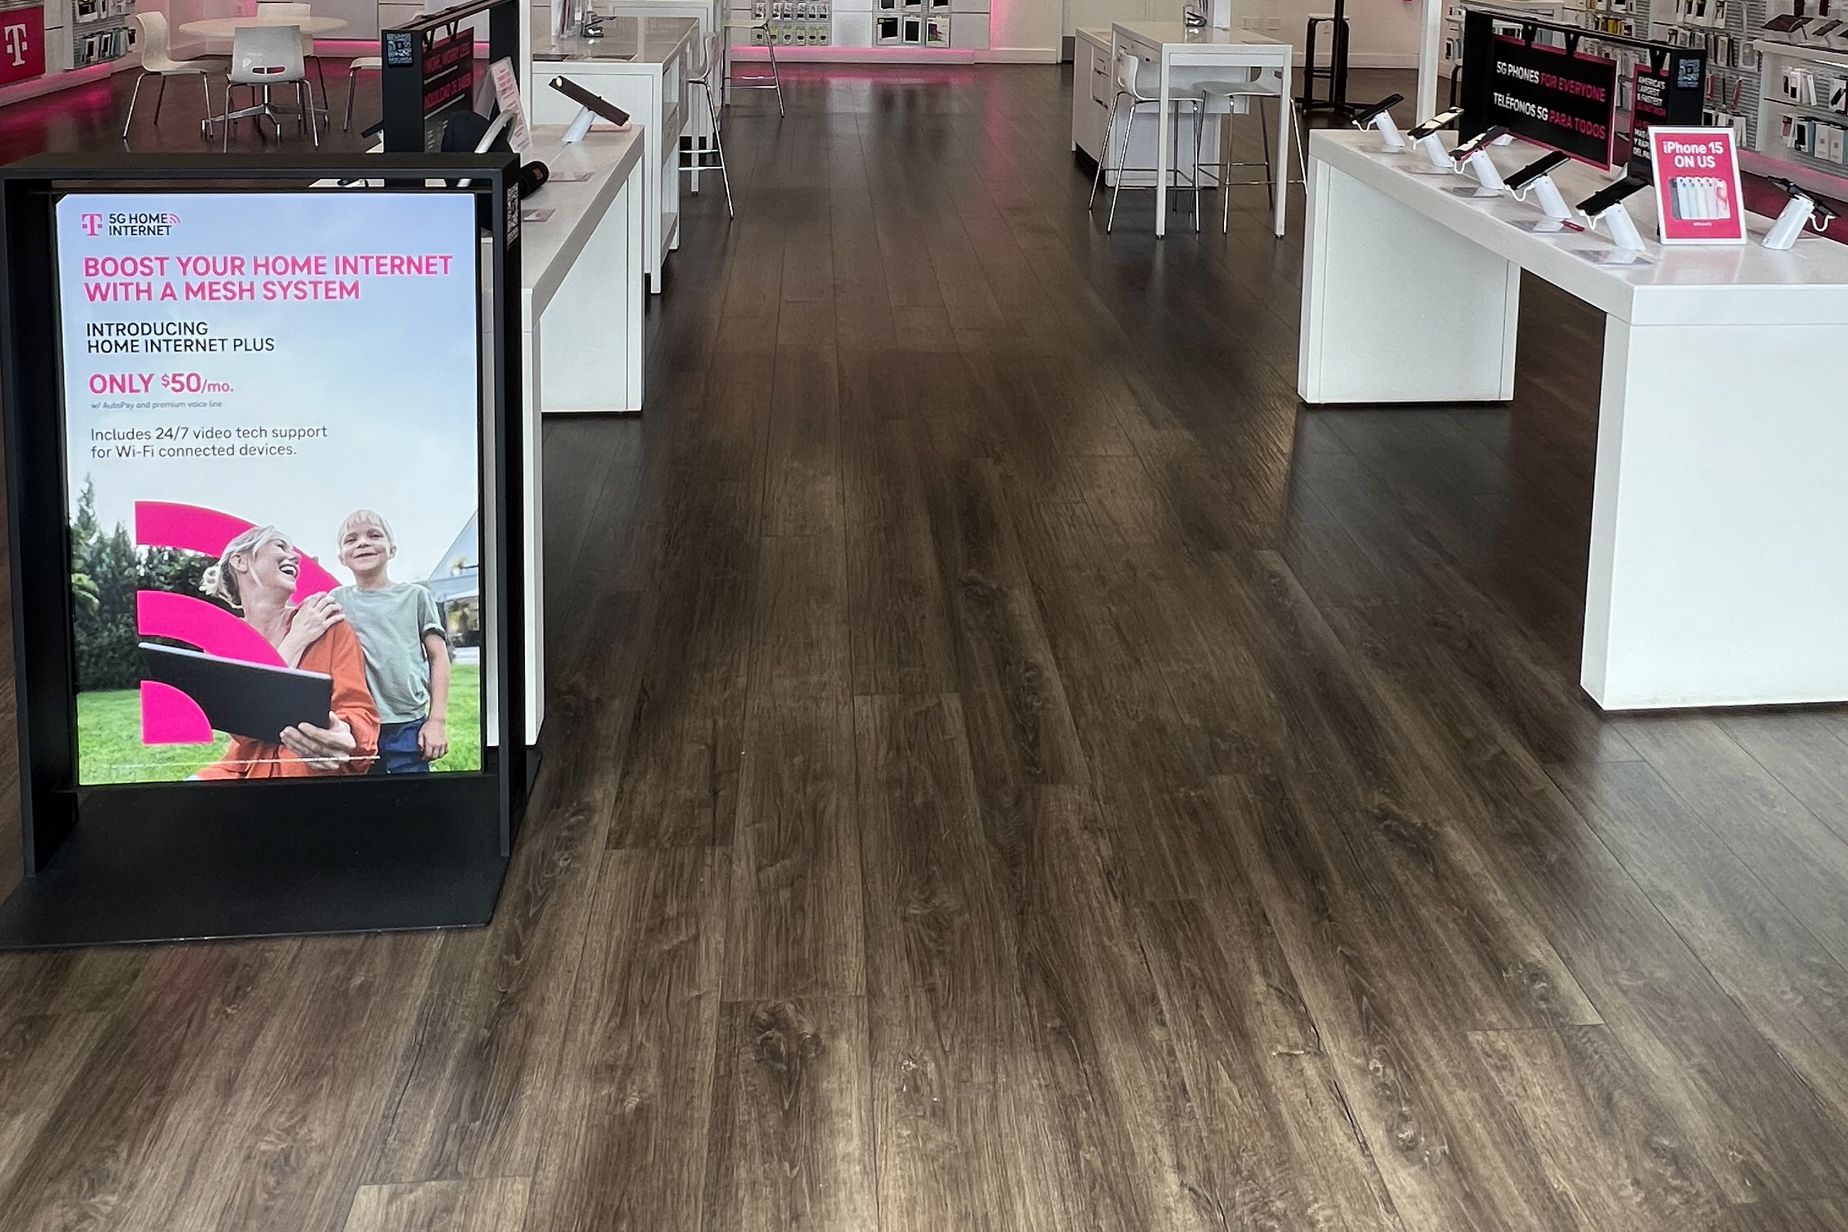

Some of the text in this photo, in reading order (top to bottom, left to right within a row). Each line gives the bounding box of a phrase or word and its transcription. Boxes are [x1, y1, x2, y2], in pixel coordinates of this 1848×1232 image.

[1496, 61, 1606, 103] 5G PHONES FOR EVERYONE
[1493, 92, 1606, 140] TELÉFONOS 5G PARA TODOS
[1662, 141, 1724, 154] iPhone 15
[1674, 155, 1716, 168] ON US
[109, 213, 168, 224] 5G HOME
[109, 225, 172, 236] INTERNET
[84, 255, 453, 277] BOOST YOUR HOME INTERNET
[84, 280, 360, 302] WITH A MESH SYSTEM
[86, 321, 209, 337] INTRODUCING
[87, 337, 275, 353] HOME INTERNET PLUS
[89, 372, 234, 394] ONLY $50/mo.
[103, 401, 135, 410] AutoPay
[152, 401, 186, 410] premium
[208, 400, 223, 408] line
[90, 426, 328, 442] Includes 24/7 video tech support
[90, 443, 297, 458] for Wi-Fi connected devices.
